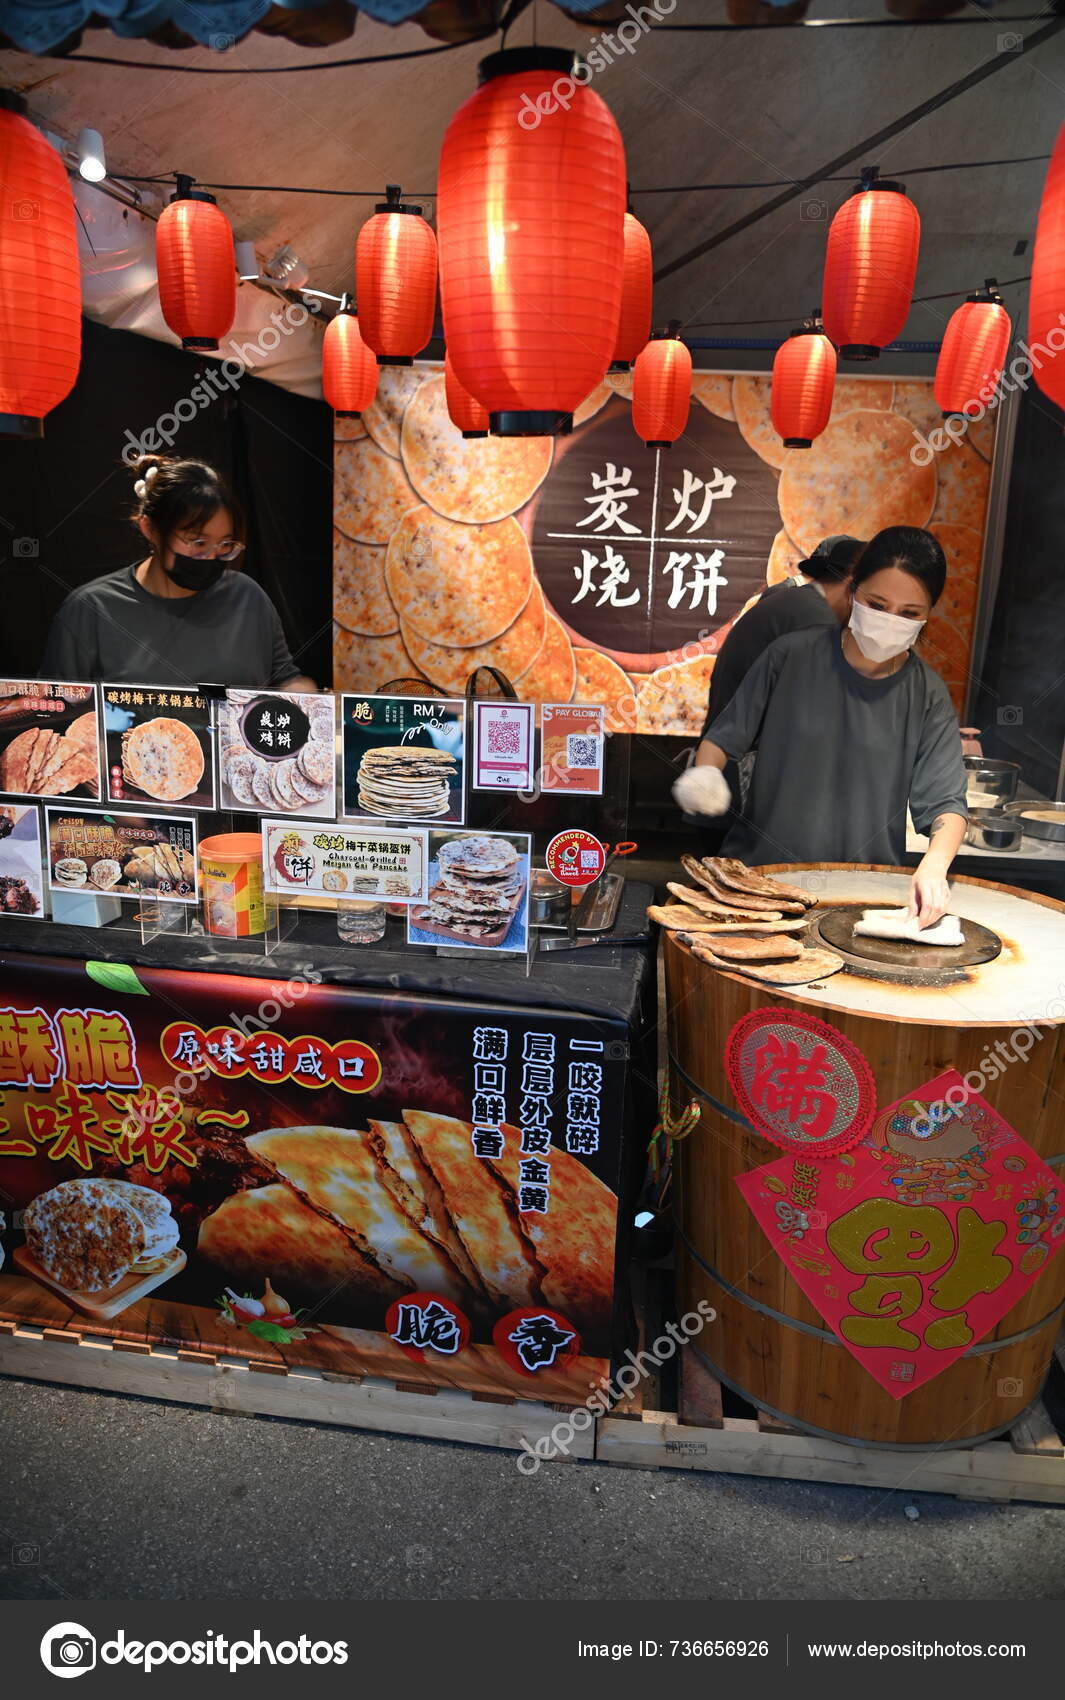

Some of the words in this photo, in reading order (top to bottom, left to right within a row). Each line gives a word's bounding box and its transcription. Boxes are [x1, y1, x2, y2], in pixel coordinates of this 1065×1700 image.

[576, 462, 737, 534] 炭炉
[571, 545, 729, 616] 烧饼
[352, 701, 373, 720] 脆
[413, 704, 434, 716] RM
[437, 705, 446, 717] 7
[429, 718, 454, 735] Only
[555, 709, 570, 717] PAY
[58, 817, 84, 826] Crispy
[323, 860, 351, 869] Meigan
[372, 863, 408, 872] Pancake
[549, 833, 585, 869] RECOMMENDED
[0, 1007, 142, 1089] 酥脆
[171, 1031, 364, 1081] 原味甜咸口
[472, 1026, 508, 1158] 满口鲜香
[566, 1038, 604, 1154] 一咬就碎
[518, 1031, 556, 1214] 层层外皮金黄
[826, 1197, 1013, 1352] 福
[390, 1300, 461, 1354] 脆
[508, 1314, 577, 1371] 香
